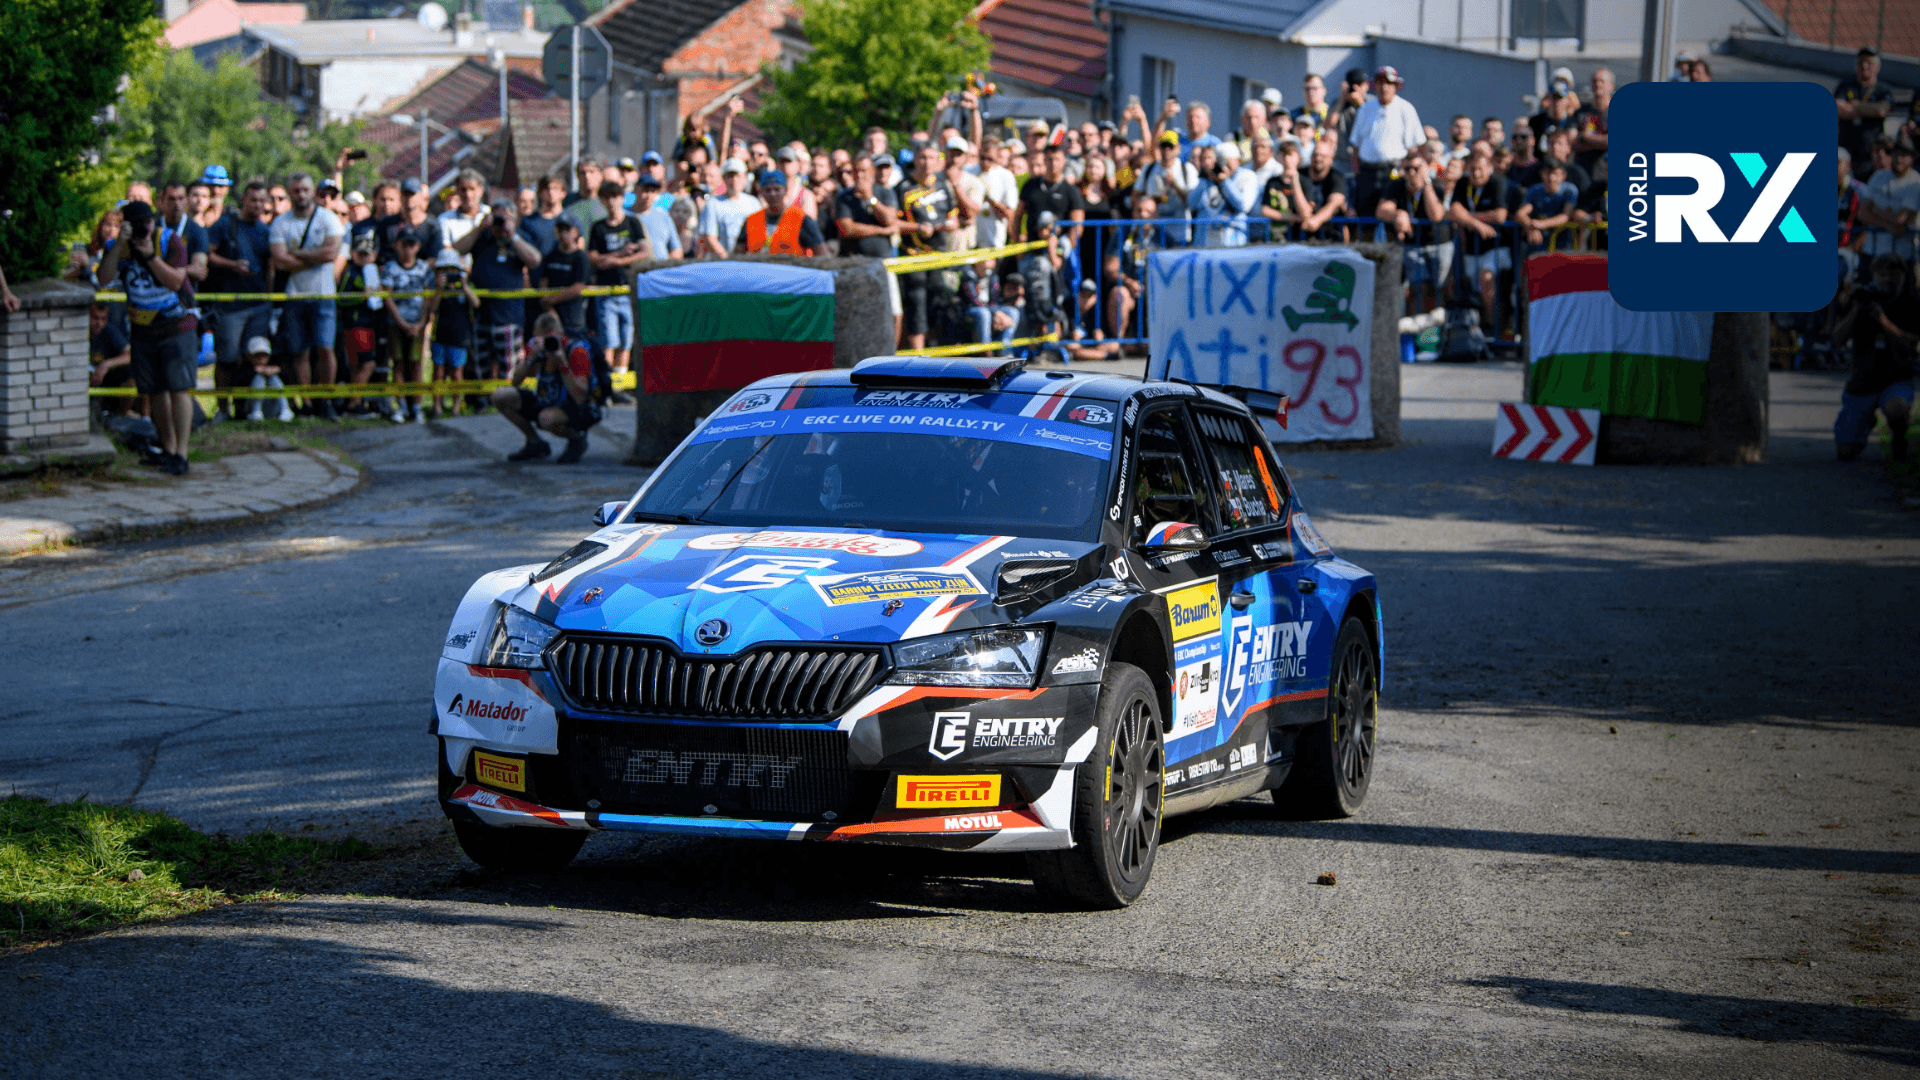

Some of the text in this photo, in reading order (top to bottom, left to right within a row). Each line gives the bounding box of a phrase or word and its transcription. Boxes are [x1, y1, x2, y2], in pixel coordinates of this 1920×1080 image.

[1278, 338, 1363, 426] 93
[856, 399, 961, 410] ENGINEERING
[864, 391, 984, 403] ENTRY
[803, 415, 1006, 432] ERC LIVE ON RALLY.TV
[1068, 407, 1115, 424] #53
[830, 585, 873, 597] BARUM
[874, 582, 911, 593] CZECH
[911, 579, 942, 590] RALLY
[1171, 602, 1210, 627] Barum
[1251, 621, 1313, 664] ENTRY
[1248, 656, 1306, 686] ENGINEERING
[466, 699, 530, 722] Matador
[506, 724, 526, 733] GROUP
[974, 717, 1065, 736] ENTRY
[972, 734, 1057, 747] ENGINEERING
[479, 757, 519, 785] PIRELLI
[623, 750, 802, 788] ENTRY
[470, 789, 501, 806] MOTUL
[906, 780, 991, 802] PIRELLI
[944, 814, 1002, 830] MOTUL
